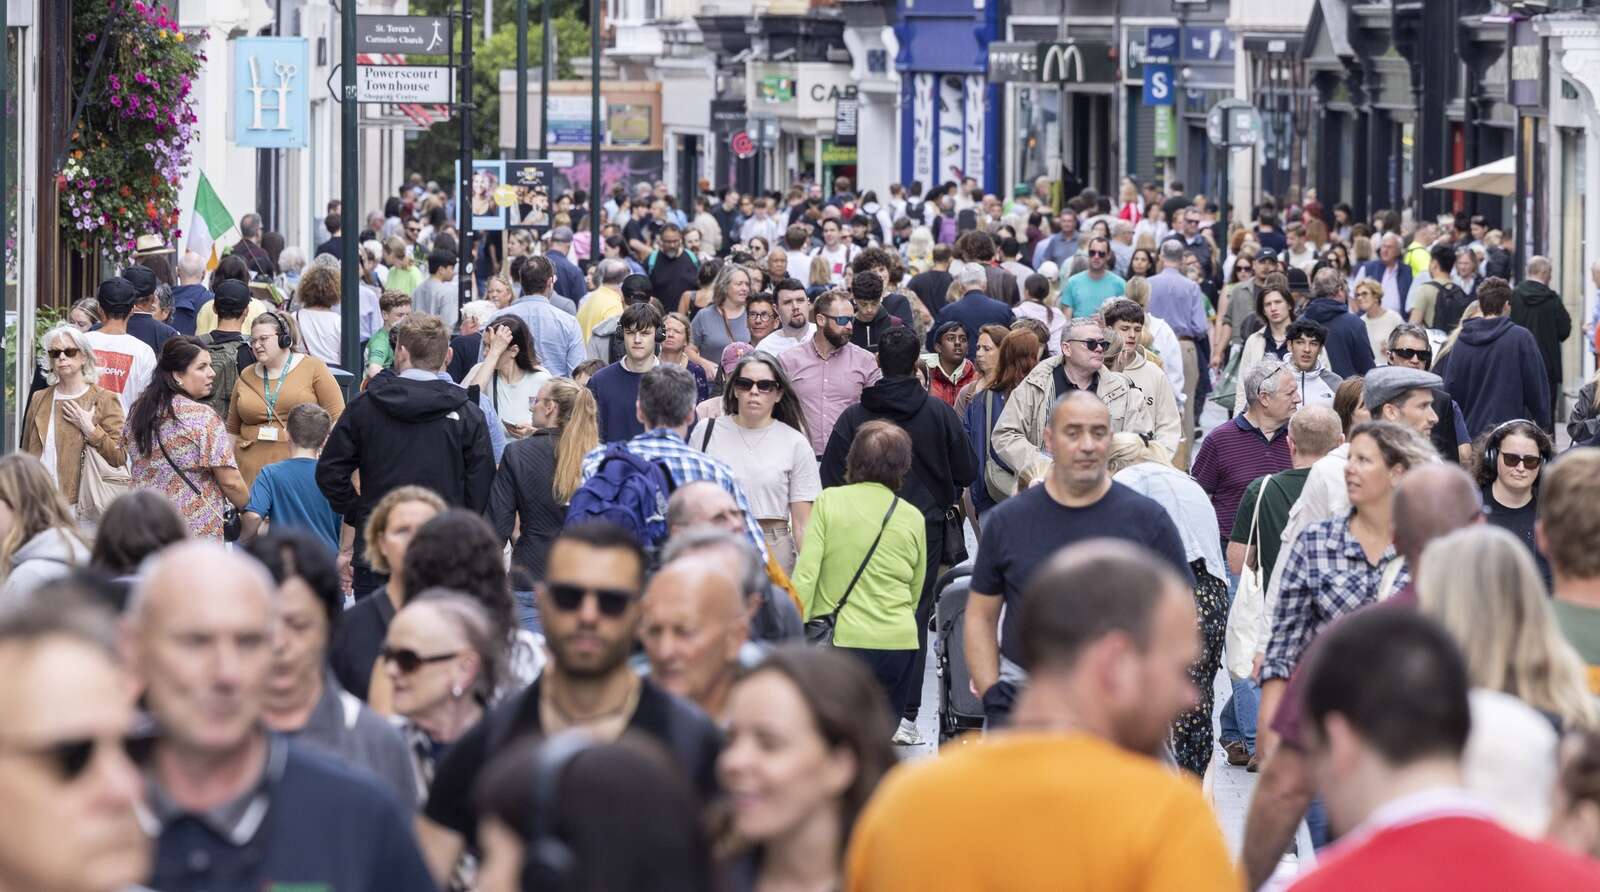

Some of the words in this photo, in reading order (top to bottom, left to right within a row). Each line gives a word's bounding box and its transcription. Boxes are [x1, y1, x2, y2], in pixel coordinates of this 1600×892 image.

[387, 24, 416, 33] Teresa's
[398, 36, 424, 45] Church
[364, 67, 438, 79] Powerscourt
[366, 80, 430, 92] Townhouse
[1151, 71, 1169, 99] S
